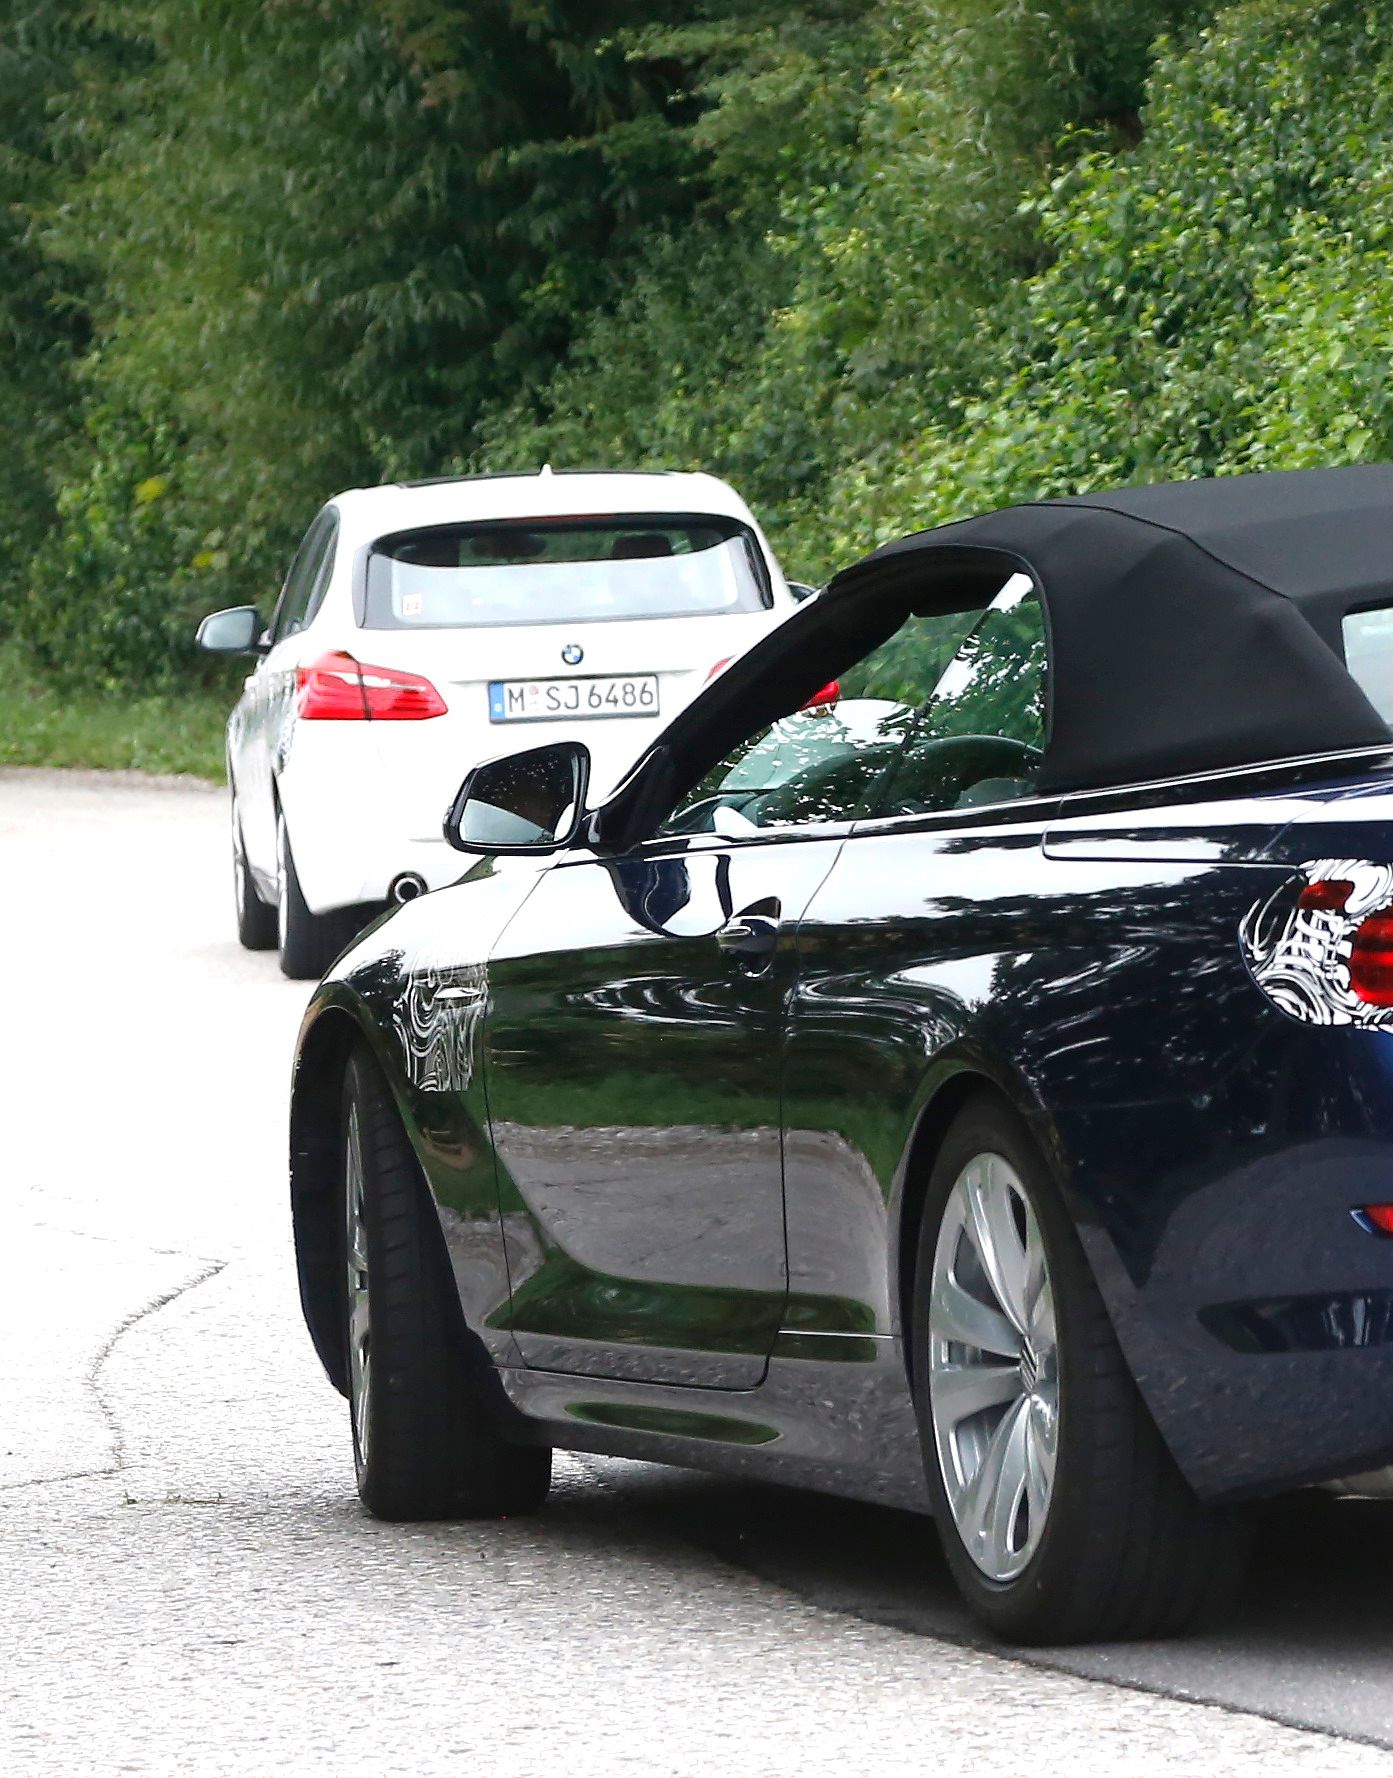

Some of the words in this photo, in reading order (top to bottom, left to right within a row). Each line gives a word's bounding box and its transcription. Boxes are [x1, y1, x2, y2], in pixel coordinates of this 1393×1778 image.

[508, 686, 525, 712] M
[545, 685, 580, 711] SJ
[587, 682, 654, 709] 6486
